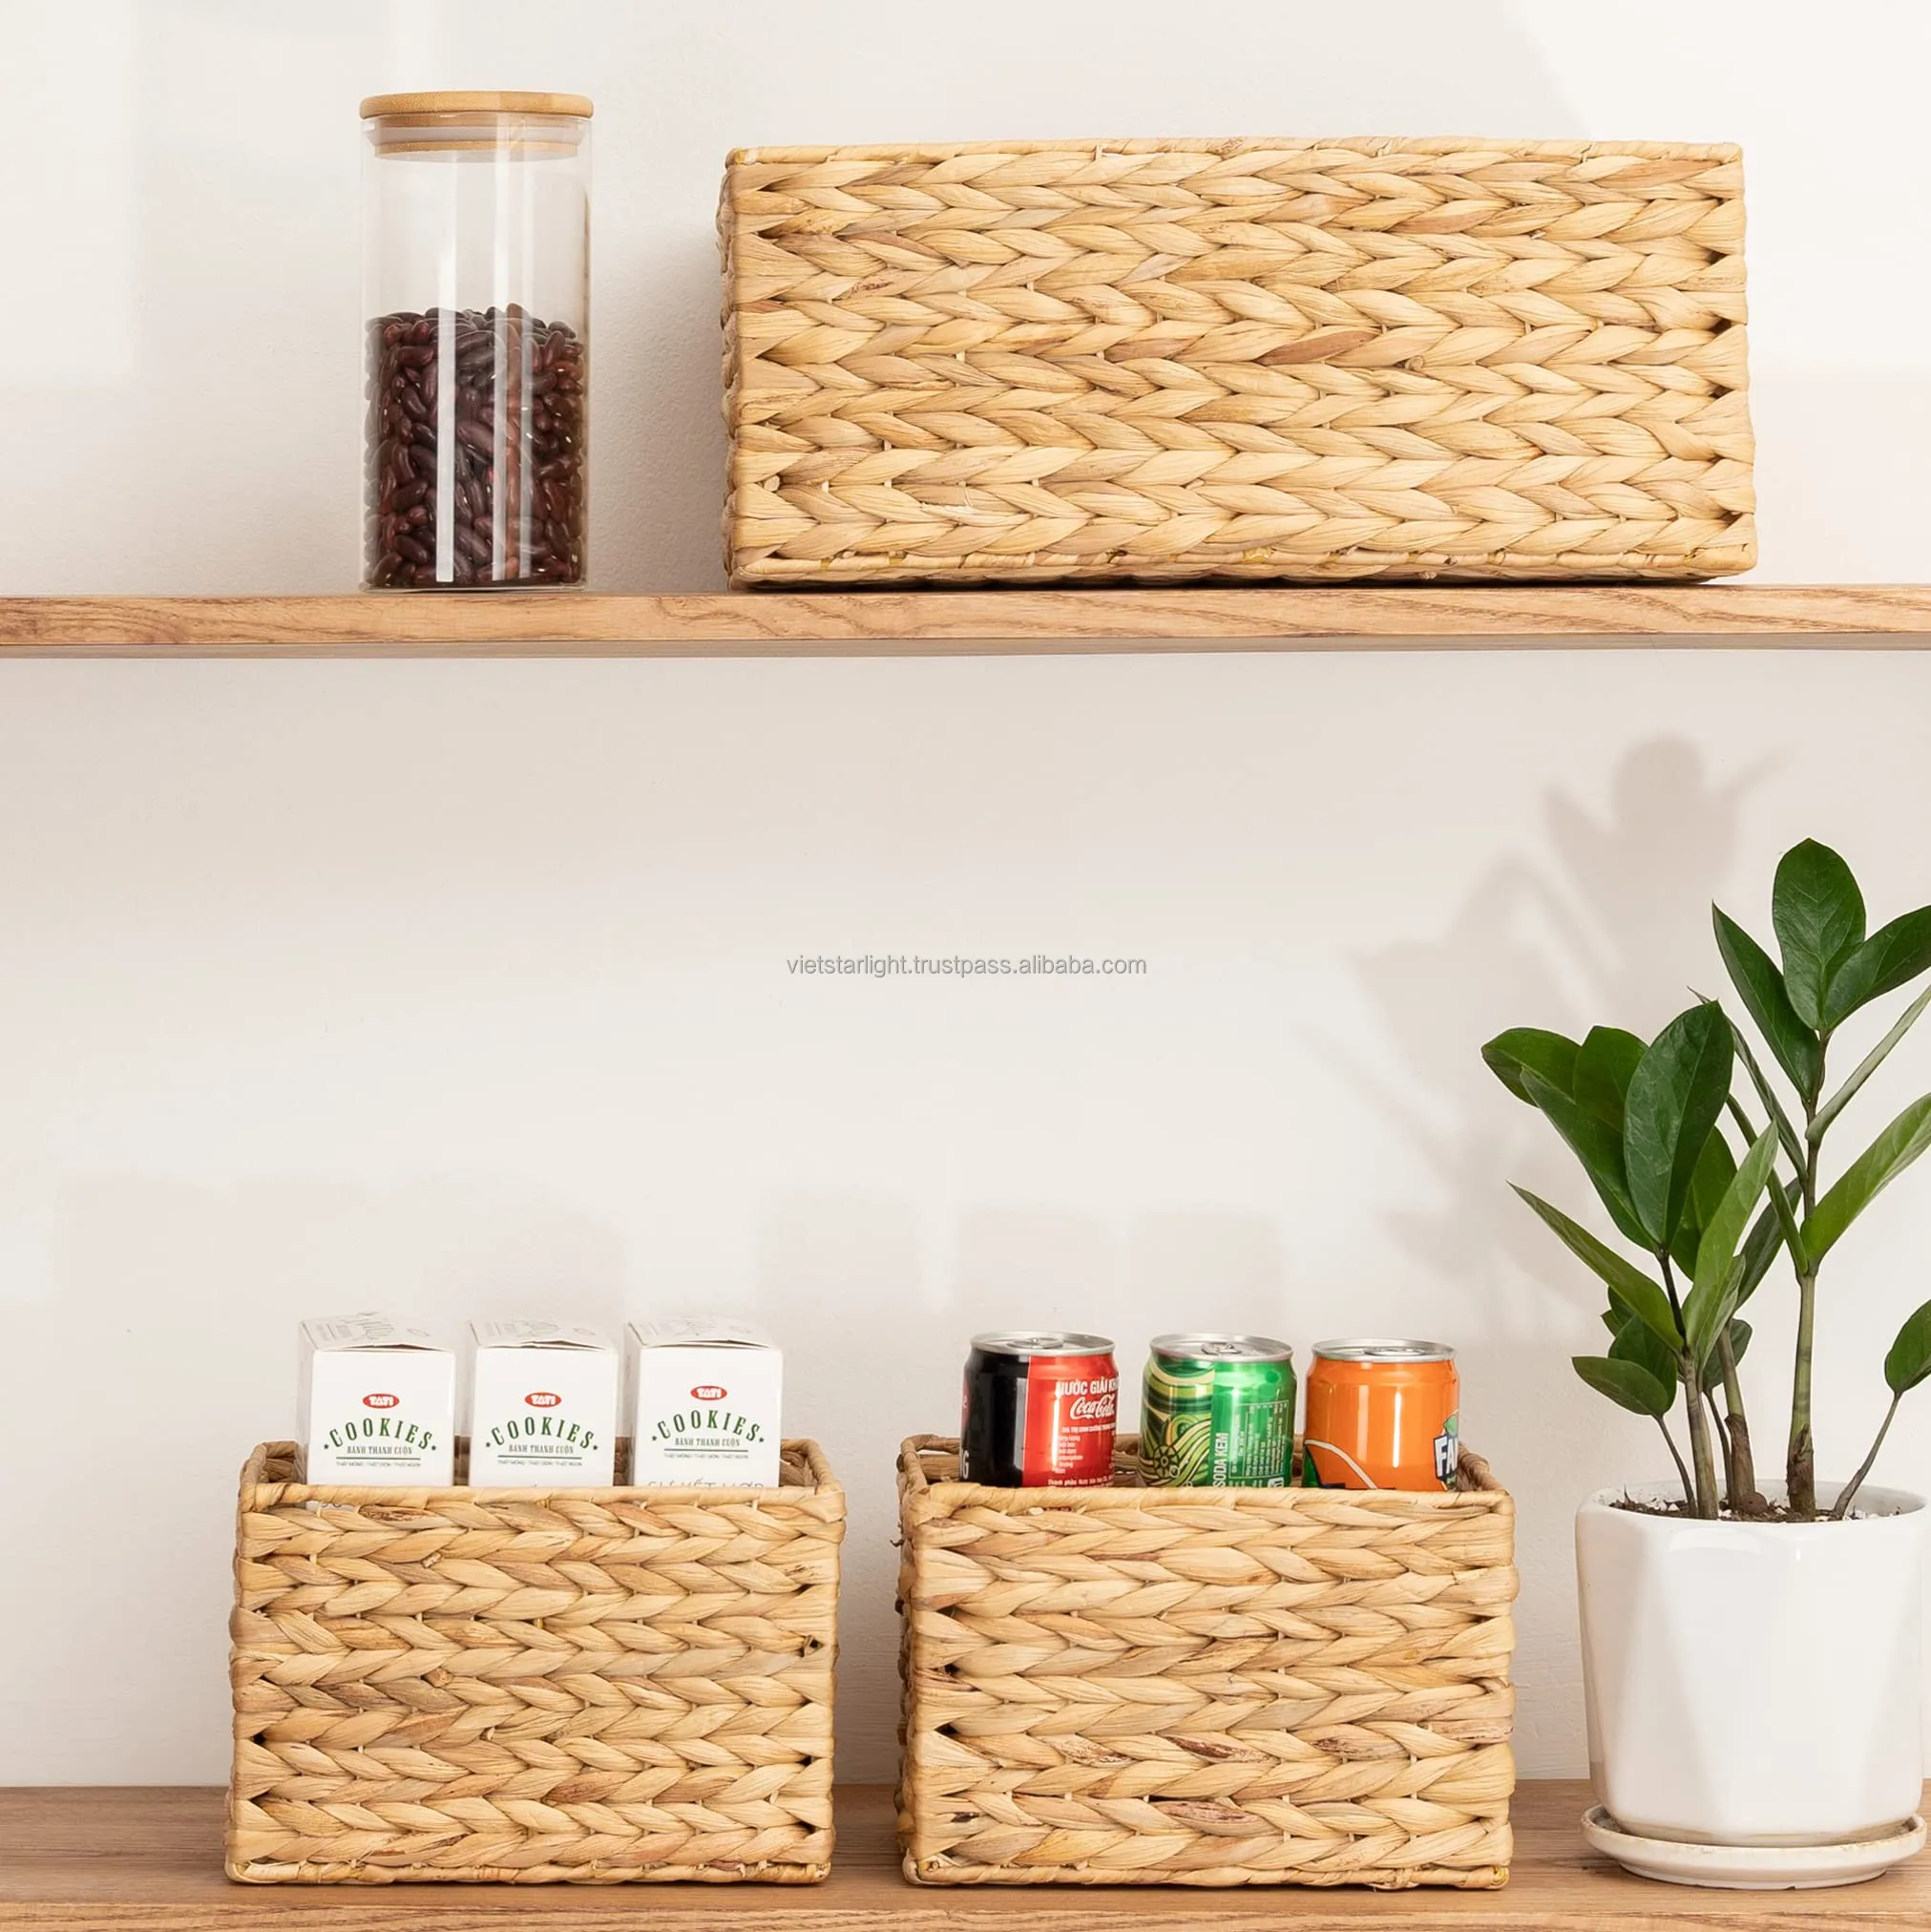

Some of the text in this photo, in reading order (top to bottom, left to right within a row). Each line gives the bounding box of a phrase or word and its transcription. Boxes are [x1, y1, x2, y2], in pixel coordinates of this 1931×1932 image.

[329, 1418, 433, 1450] COOKIES
[491, 1417, 595, 1449] COOKIES
[657, 1409, 761, 1442] COOKIES
[1212, 1460, 1228, 1487] SODA
